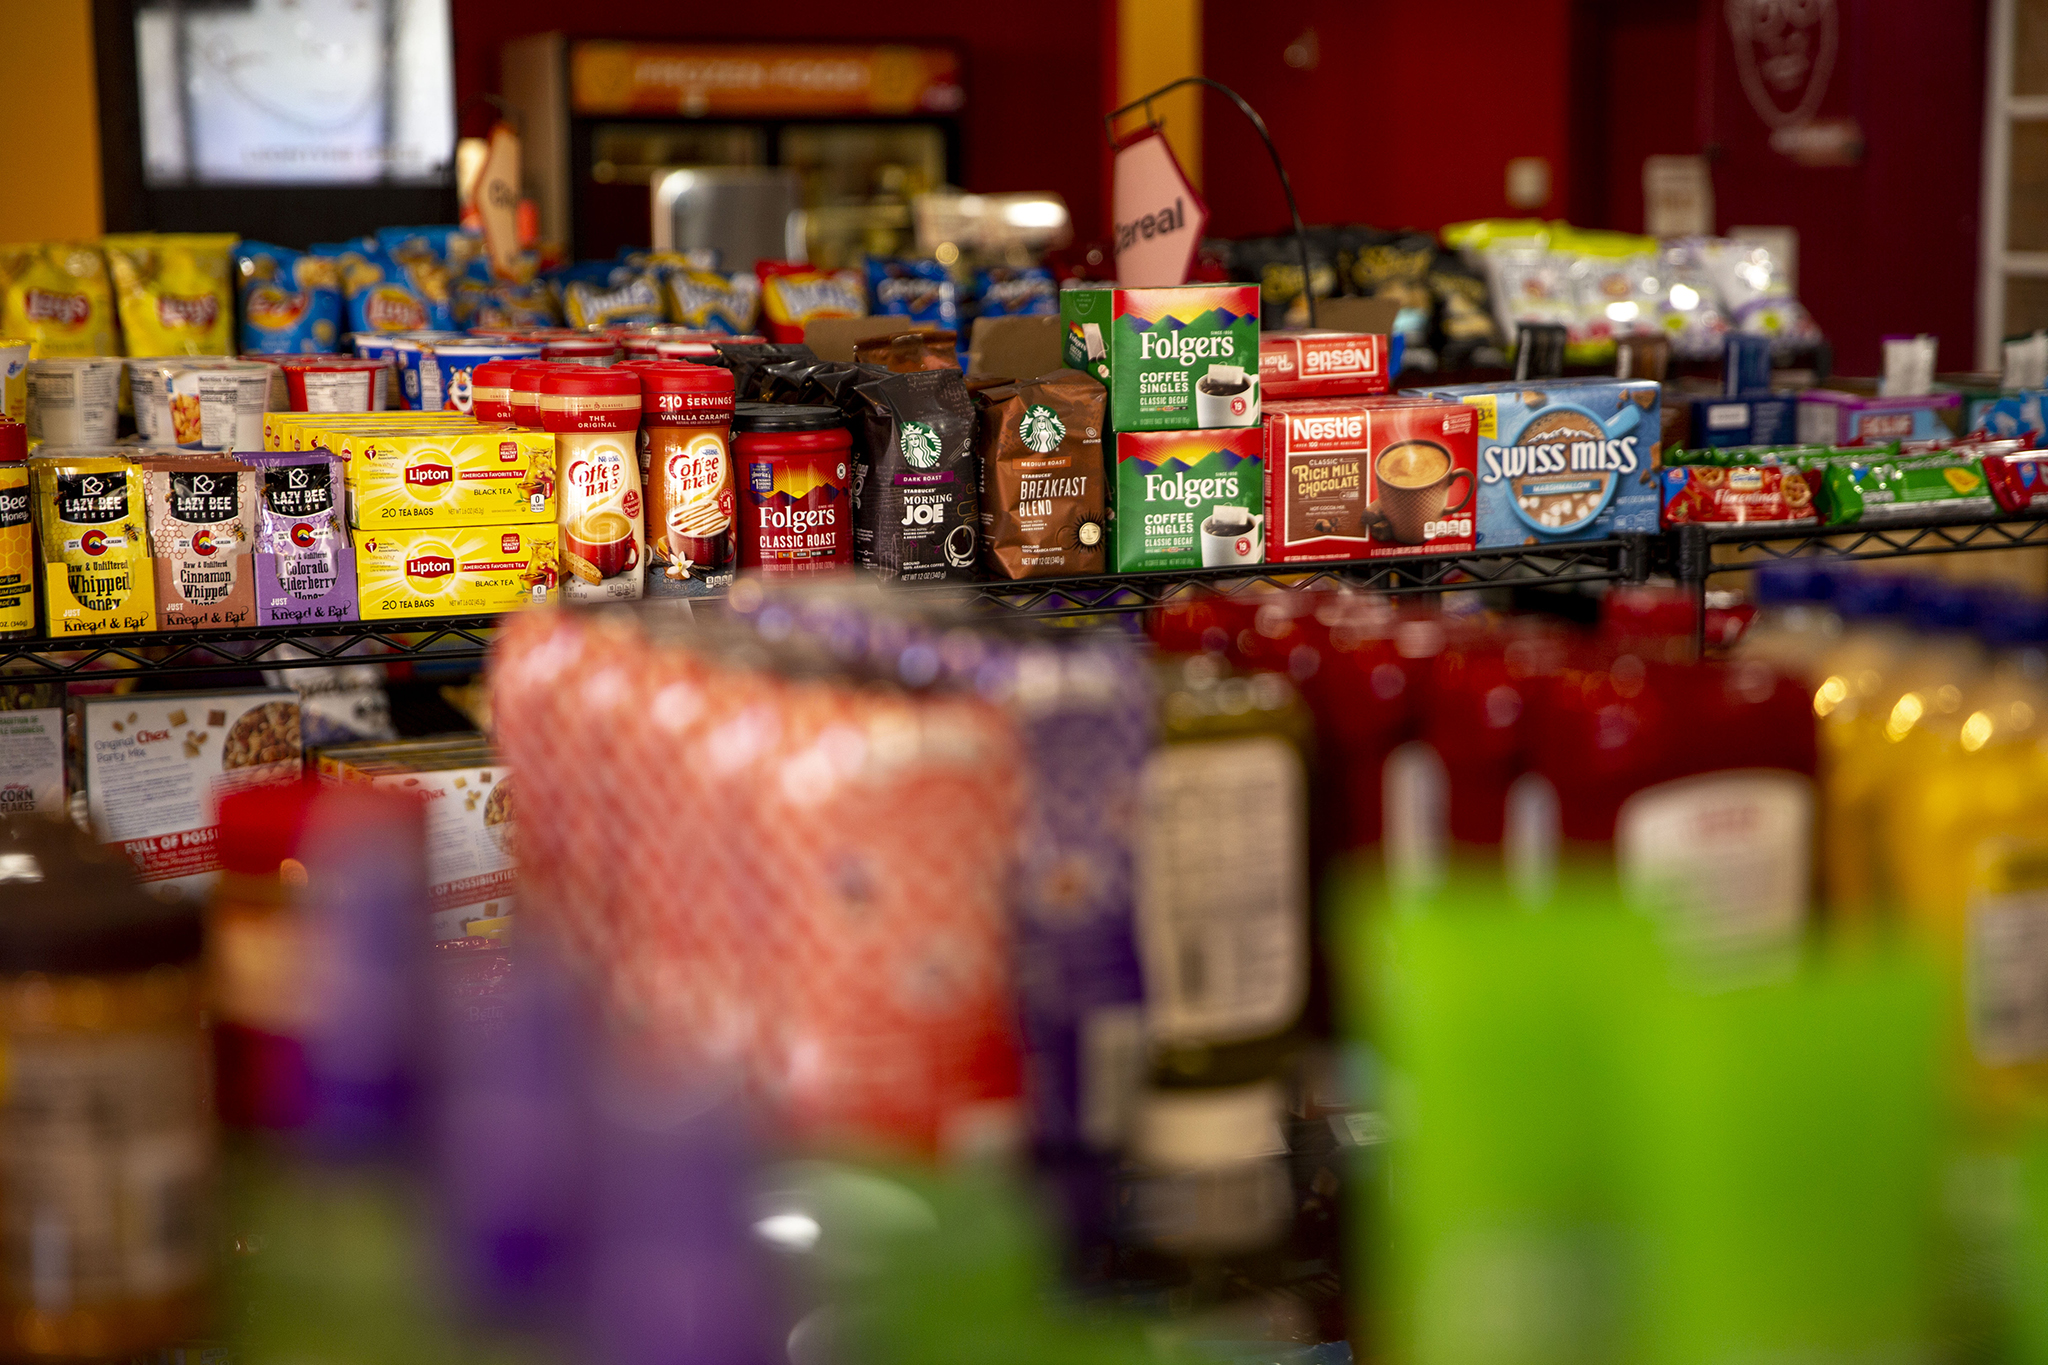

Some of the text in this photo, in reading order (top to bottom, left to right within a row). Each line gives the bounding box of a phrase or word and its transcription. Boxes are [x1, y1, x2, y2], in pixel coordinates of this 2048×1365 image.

[1140, 330, 1234, 366] Folgers
[1140, 371, 1189, 383] COFFEE
[1140, 382, 1189, 393] SINGLES
[659, 396, 732, 408] 210 SERVINGS
[1140, 396, 1188, 405] CLASSIC DECAF
[1234, 402, 1243, 410] 19
[1478, 407, 1493, 421] 3%
[1293, 416, 1364, 440] Nestlé
[1309, 458, 1338, 466] CLASSIC
[1482, 436, 1638, 484] SWISS MISS
[409, 469, 449, 483] Lipton
[1292, 462, 1359, 483] RICH MILK
[474, 488, 497, 496] BLACK
[1020, 476, 1087, 500] BREAKFAST
[1144, 471, 1239, 508] Folgers
[1298, 475, 1359, 498] CHOCOLATE
[1532, 481, 1591, 492] MARSHMALLOW
[0, 495, 27, 512] Bee
[177, 496, 232, 511] LAZY BEE
[272, 488, 327, 505] LAZY BEE
[903, 493, 953, 505] MORNING
[65, 496, 122, 513] LAZY BEE
[1019, 499, 1052, 517] BLEND
[1, 512, 28, 523] Honey
[74, 511, 115, 519] RANCH
[381, 508, 434, 518] 20 TEA BAGS
[759, 505, 835, 534] Folgers
[901, 503, 944, 526] JOE
[1144, 512, 1194, 524] COFFEE
[1144, 523, 1194, 535] SINGLES
[759, 532, 836, 548] CLASSIC ROAST
[1144, 537, 1193, 547] CLASSIC DECAF
[1239, 542, 1247, 551] 19
[85, 562, 90, 571] &
[93, 560, 128, 571] Unfiltered
[285, 560, 329, 576] Colorado
[410, 561, 450, 575] Lipton
[1021, 557, 1031, 565] NET
[1031, 557, 1039, 565] WT
[180, 569, 231, 583] Cinnamon
[68, 572, 131, 596] Whipped
[280, 576, 337, 591] Elderberry
[183, 583, 228, 600] Whipped
[166, 603, 184, 611] JUST
[270, 597, 287, 606] JUST
[382, 599, 435, 610] 20 TEA BAGS
[63, 609, 81, 618] JUST
[167, 607, 248, 627] Knead & Eat
[271, 601, 351, 623] Knead & Eat
[64, 612, 148, 634] Knead & Eat
[94, 729, 172, 752] Original Chex
[96, 751, 126, 763] Party
[0, 789, 34, 802] CORN
[0, 801, 36, 812] FLAKES
[124, 828, 219, 855] FULL OF POSSI
[451, 868, 519, 892] POSSIBILITIES
